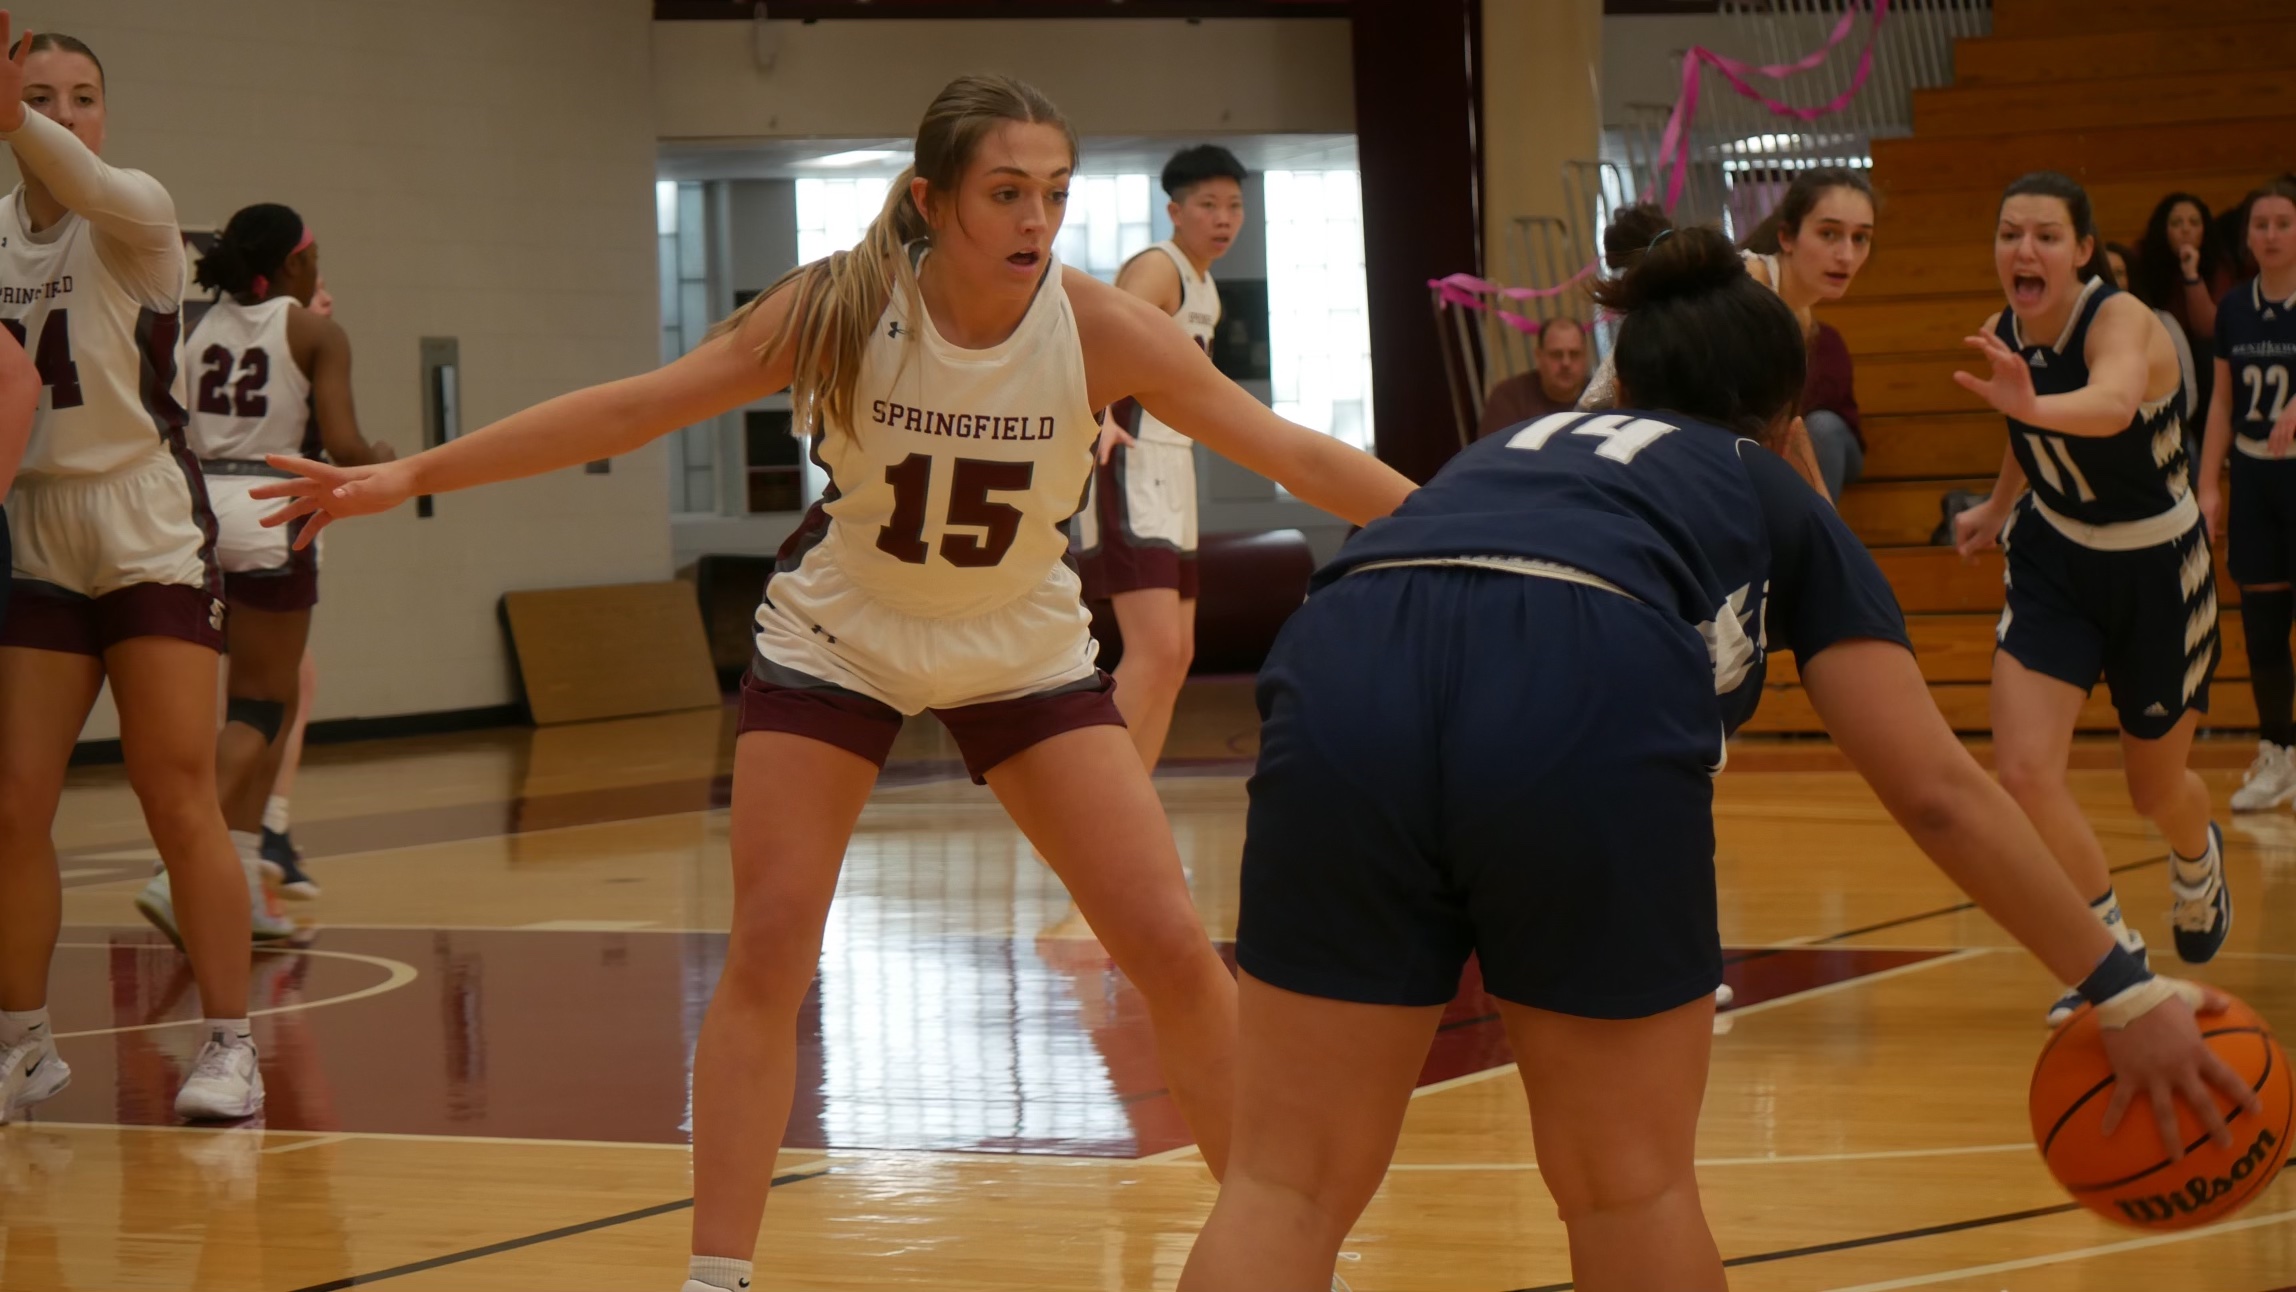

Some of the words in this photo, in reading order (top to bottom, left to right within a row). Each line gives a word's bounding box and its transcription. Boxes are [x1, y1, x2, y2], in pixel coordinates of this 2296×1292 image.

[197, 343, 269, 417] 22
[2243, 364, 2289, 421] 22
[872, 399, 1055, 441] SPRINGFIELD
[1505, 411, 1681, 465] 14
[2023, 433, 2097, 503] 11
[876, 452, 1034, 568] 15
[2114, 1128, 2277, 1222] Wilson
